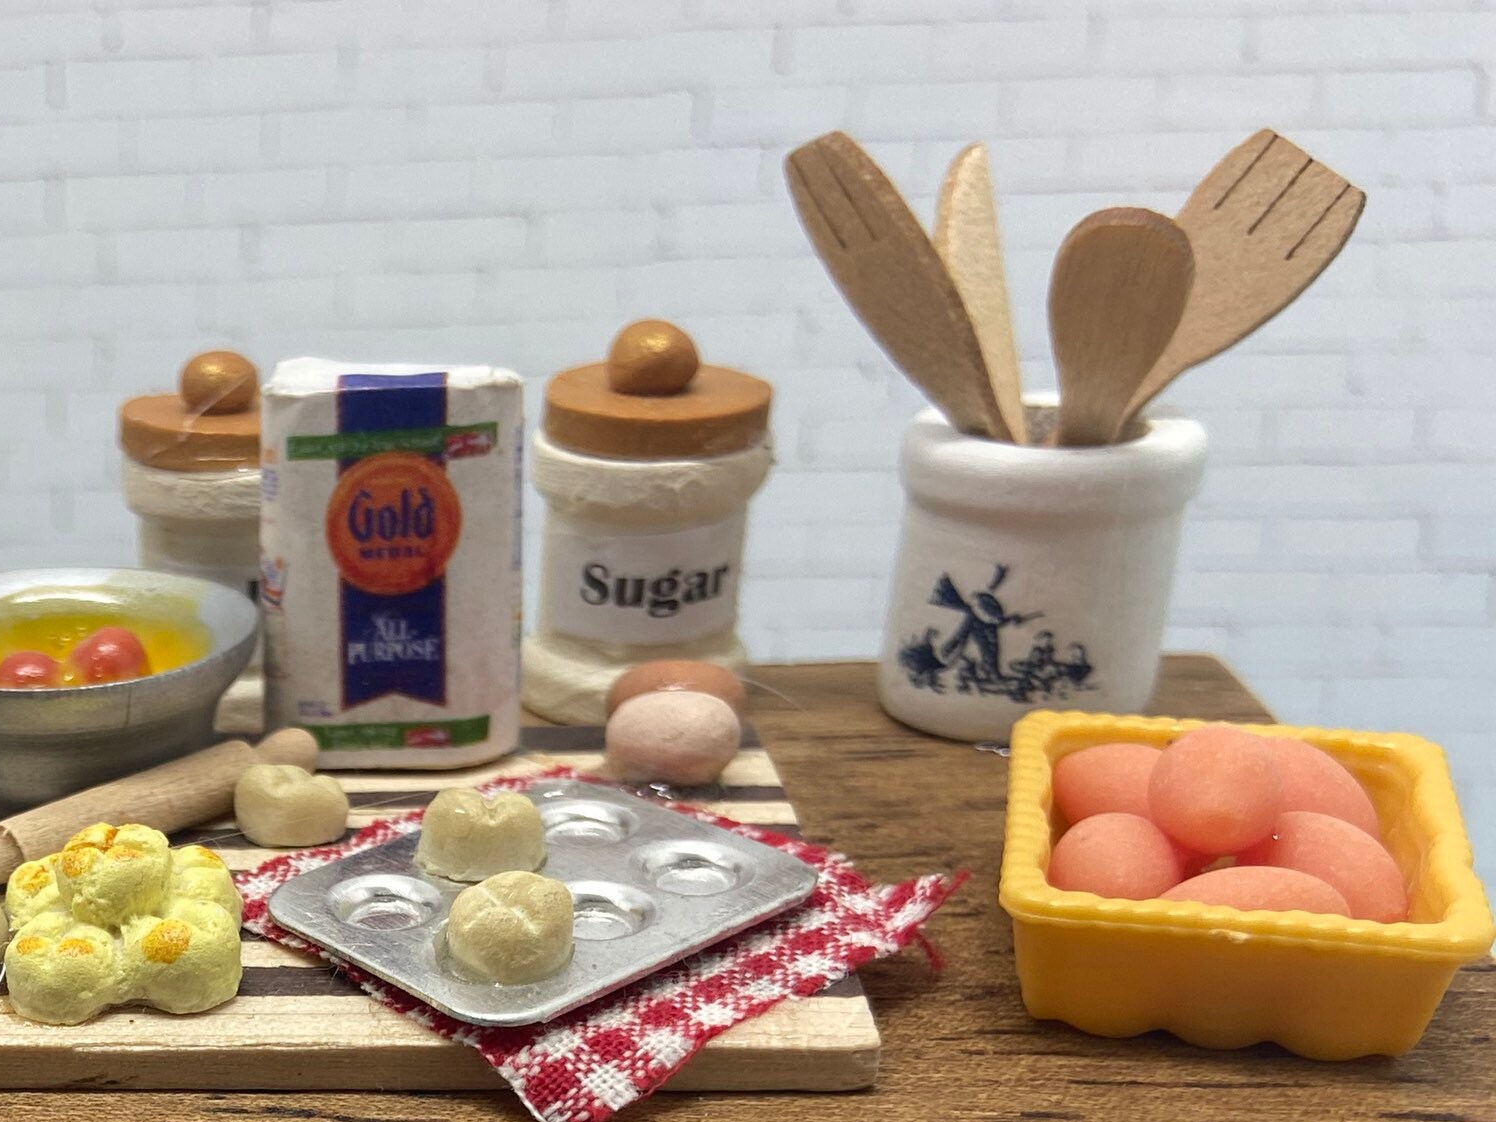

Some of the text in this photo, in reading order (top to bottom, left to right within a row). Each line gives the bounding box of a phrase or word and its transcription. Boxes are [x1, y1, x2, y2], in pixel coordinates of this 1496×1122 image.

[348, 488, 435, 542] Gold
[580, 563, 729, 618] Sugar
[347, 639, 440, 665] PURPOSE
